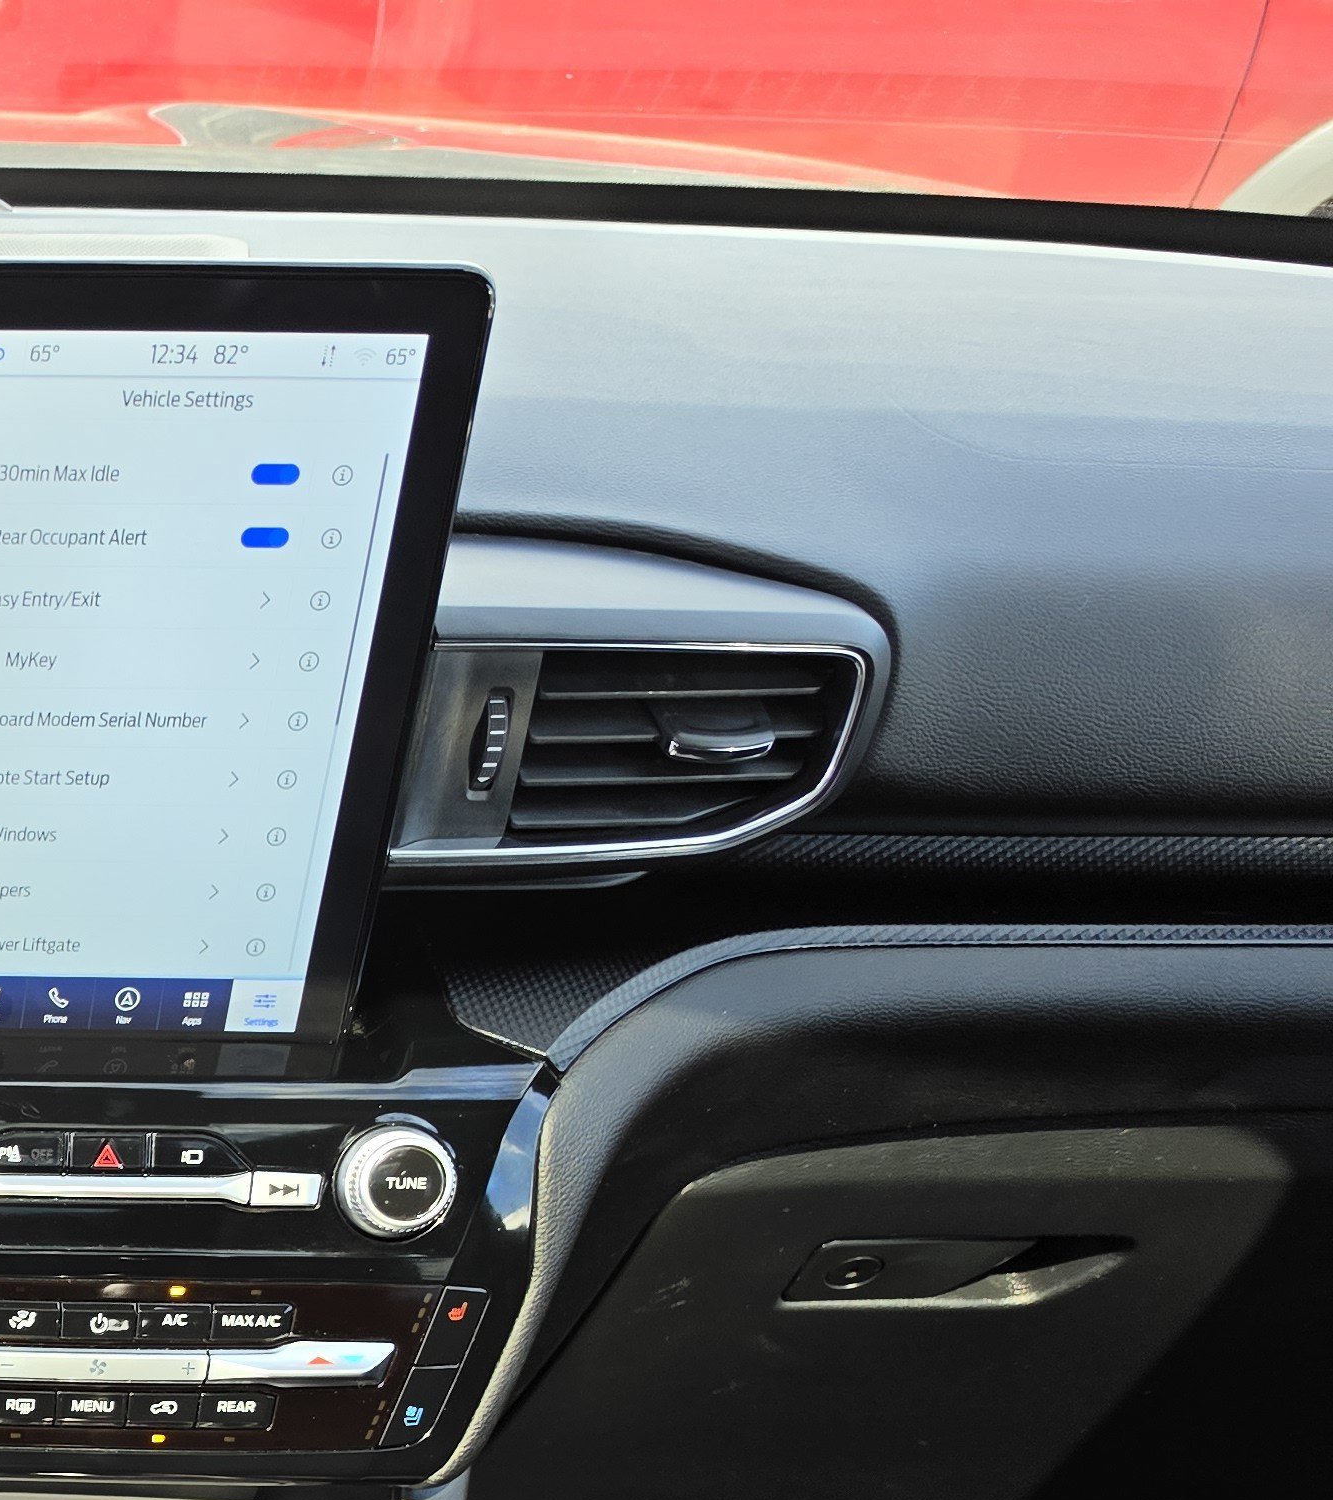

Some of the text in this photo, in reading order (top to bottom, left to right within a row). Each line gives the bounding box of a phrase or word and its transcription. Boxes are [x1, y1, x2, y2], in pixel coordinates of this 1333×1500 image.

[29, 344, 60, 363] 65°
[150, 344, 249, 365] 12:34 82°
[385, 347, 417, 366] 65°
[122, 390, 254, 411] Vehicle Settings
[53, 464, 87, 482] Max
[90, 464, 120, 482] Idle
[30, 528, 106, 550] Occupant
[109, 529, 148, 547] Alert
[22, 590, 101, 610] Entry/Exit
[5, 651, 57, 672] MyKey
[36, 710, 95, 728] Modem
[98, 711, 142, 729] Serial
[145, 711, 207, 730] Number
[23, 769, 62, 787] Start
[64, 769, 111, 790] Setup
[21, 936, 81, 957] Liftgate
[43, 1014, 68, 1024] Phone
[115, 1015, 132, 1025] Nav
[181, 1015, 203, 1027] Apps
[243, 1016, 279, 1028] Settings
[385, 1175, 428, 1191] TUNE
[161, 1313, 188, 1327] A/C
[221, 1314, 282, 1328] MAX A/C
[71, 1400, 115, 1413] MENU
[216, 1401, 257, 1414] REAR
